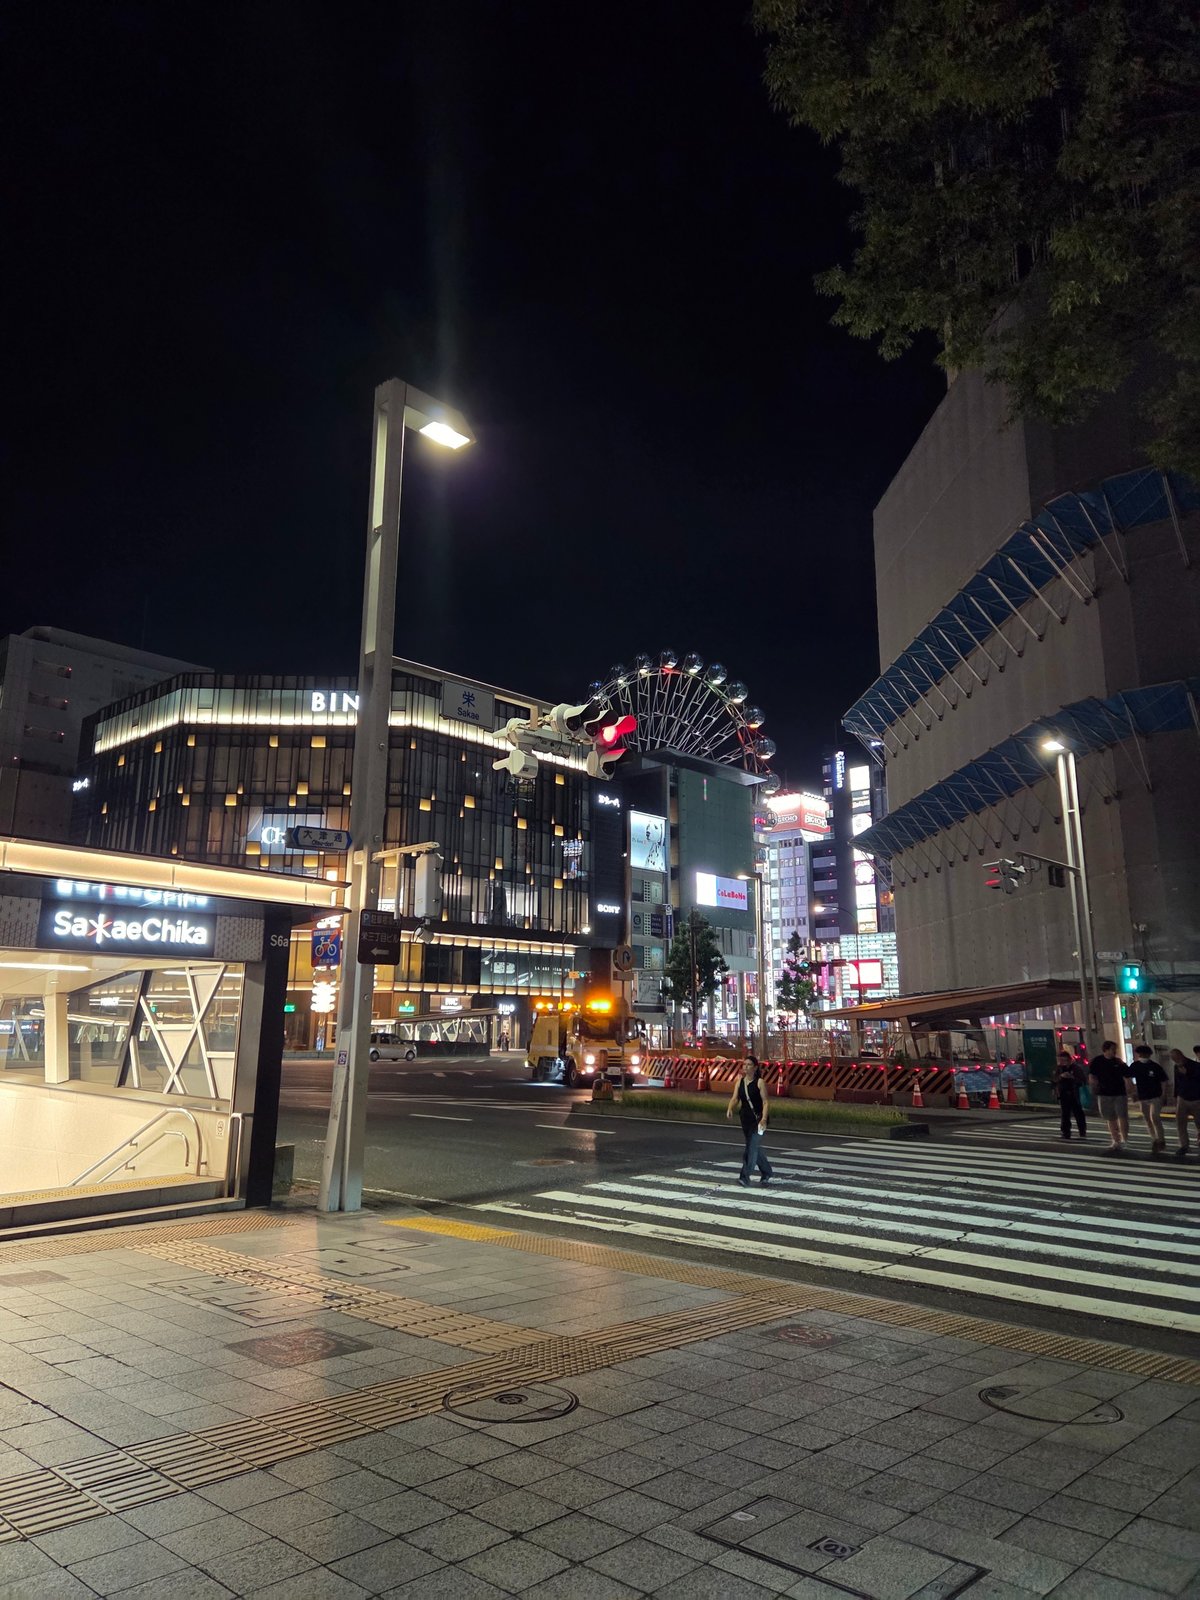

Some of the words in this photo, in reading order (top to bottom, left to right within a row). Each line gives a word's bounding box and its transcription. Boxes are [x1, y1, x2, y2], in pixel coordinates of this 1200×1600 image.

[311, 691, 360, 712] BIN
[462, 690, 476, 708] 栄
[457, 706, 480, 721] Sakae
[303, 829, 342, 843] 大津通
[597, 903, 621, 914] SONY
[269, 934, 289, 948] S6a
